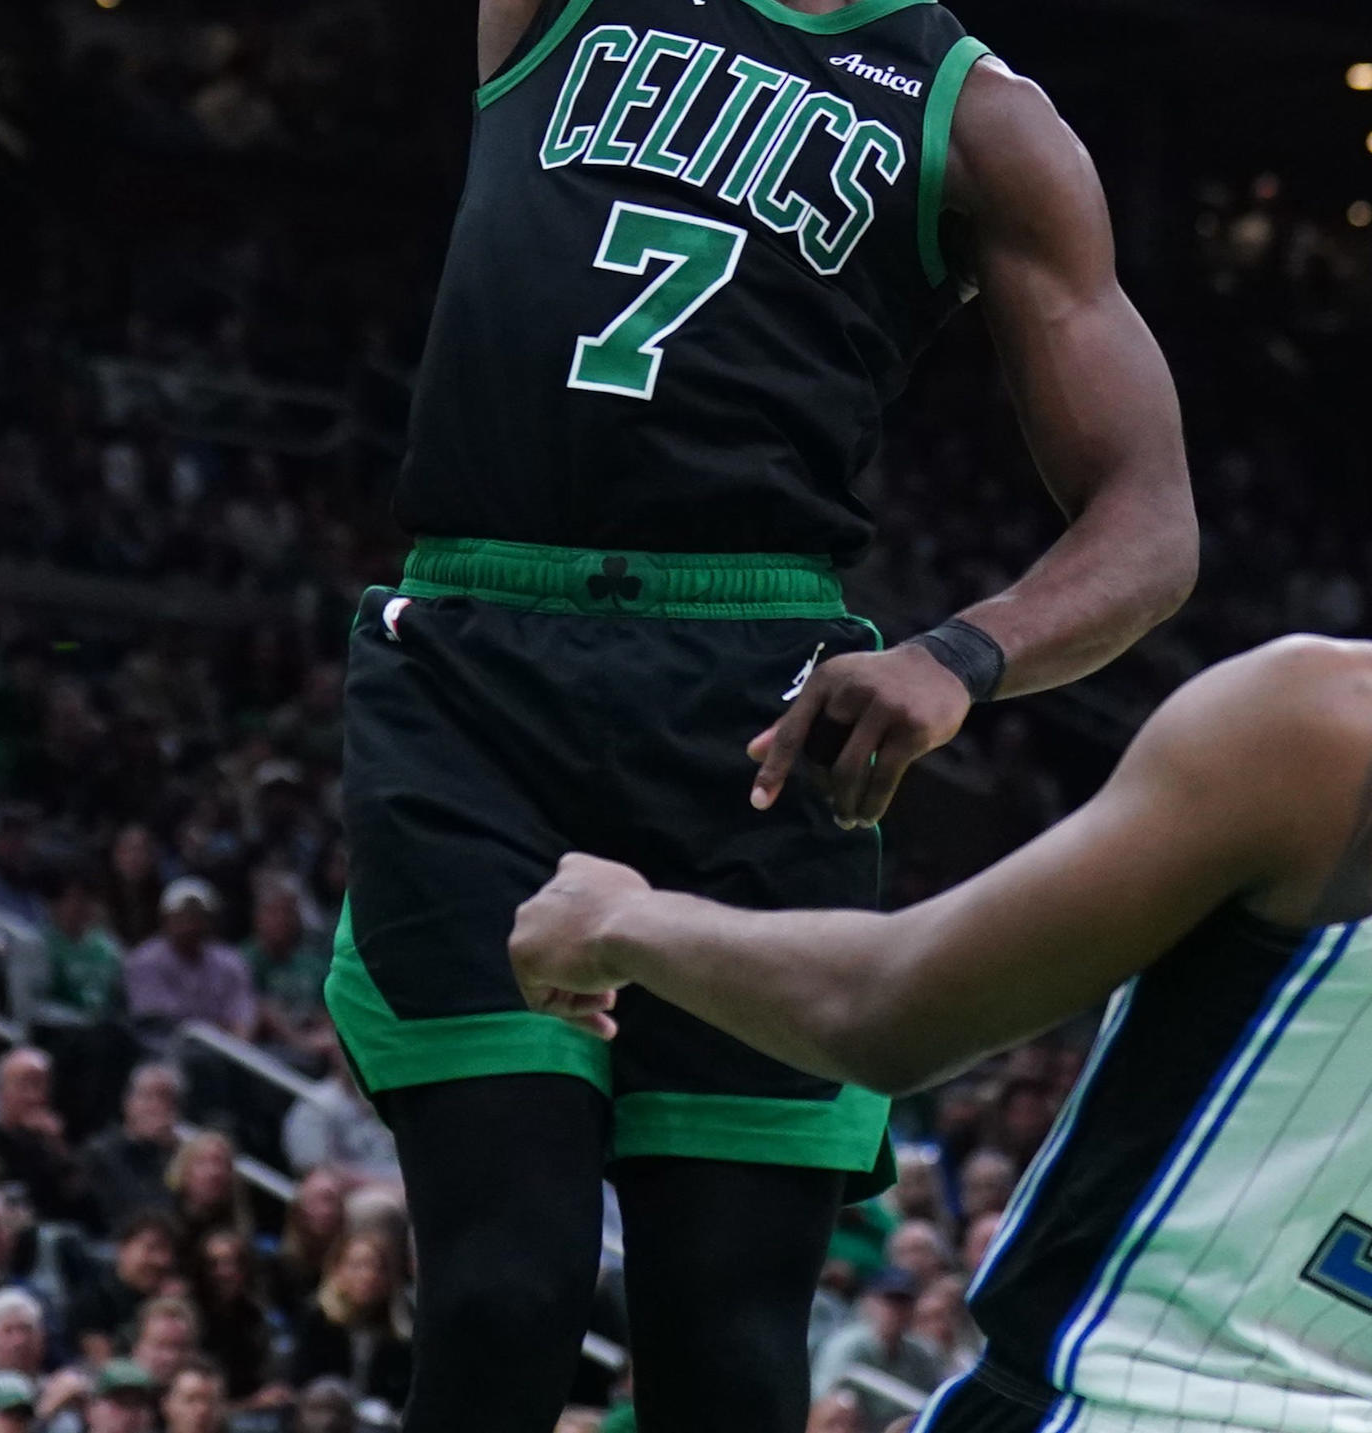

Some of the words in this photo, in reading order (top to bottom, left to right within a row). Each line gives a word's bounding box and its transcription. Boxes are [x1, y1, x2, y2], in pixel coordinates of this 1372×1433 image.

[539, 24, 906, 276] CELTICS
[829, 54, 923, 98] Amica
[566, 200, 748, 401] 7
